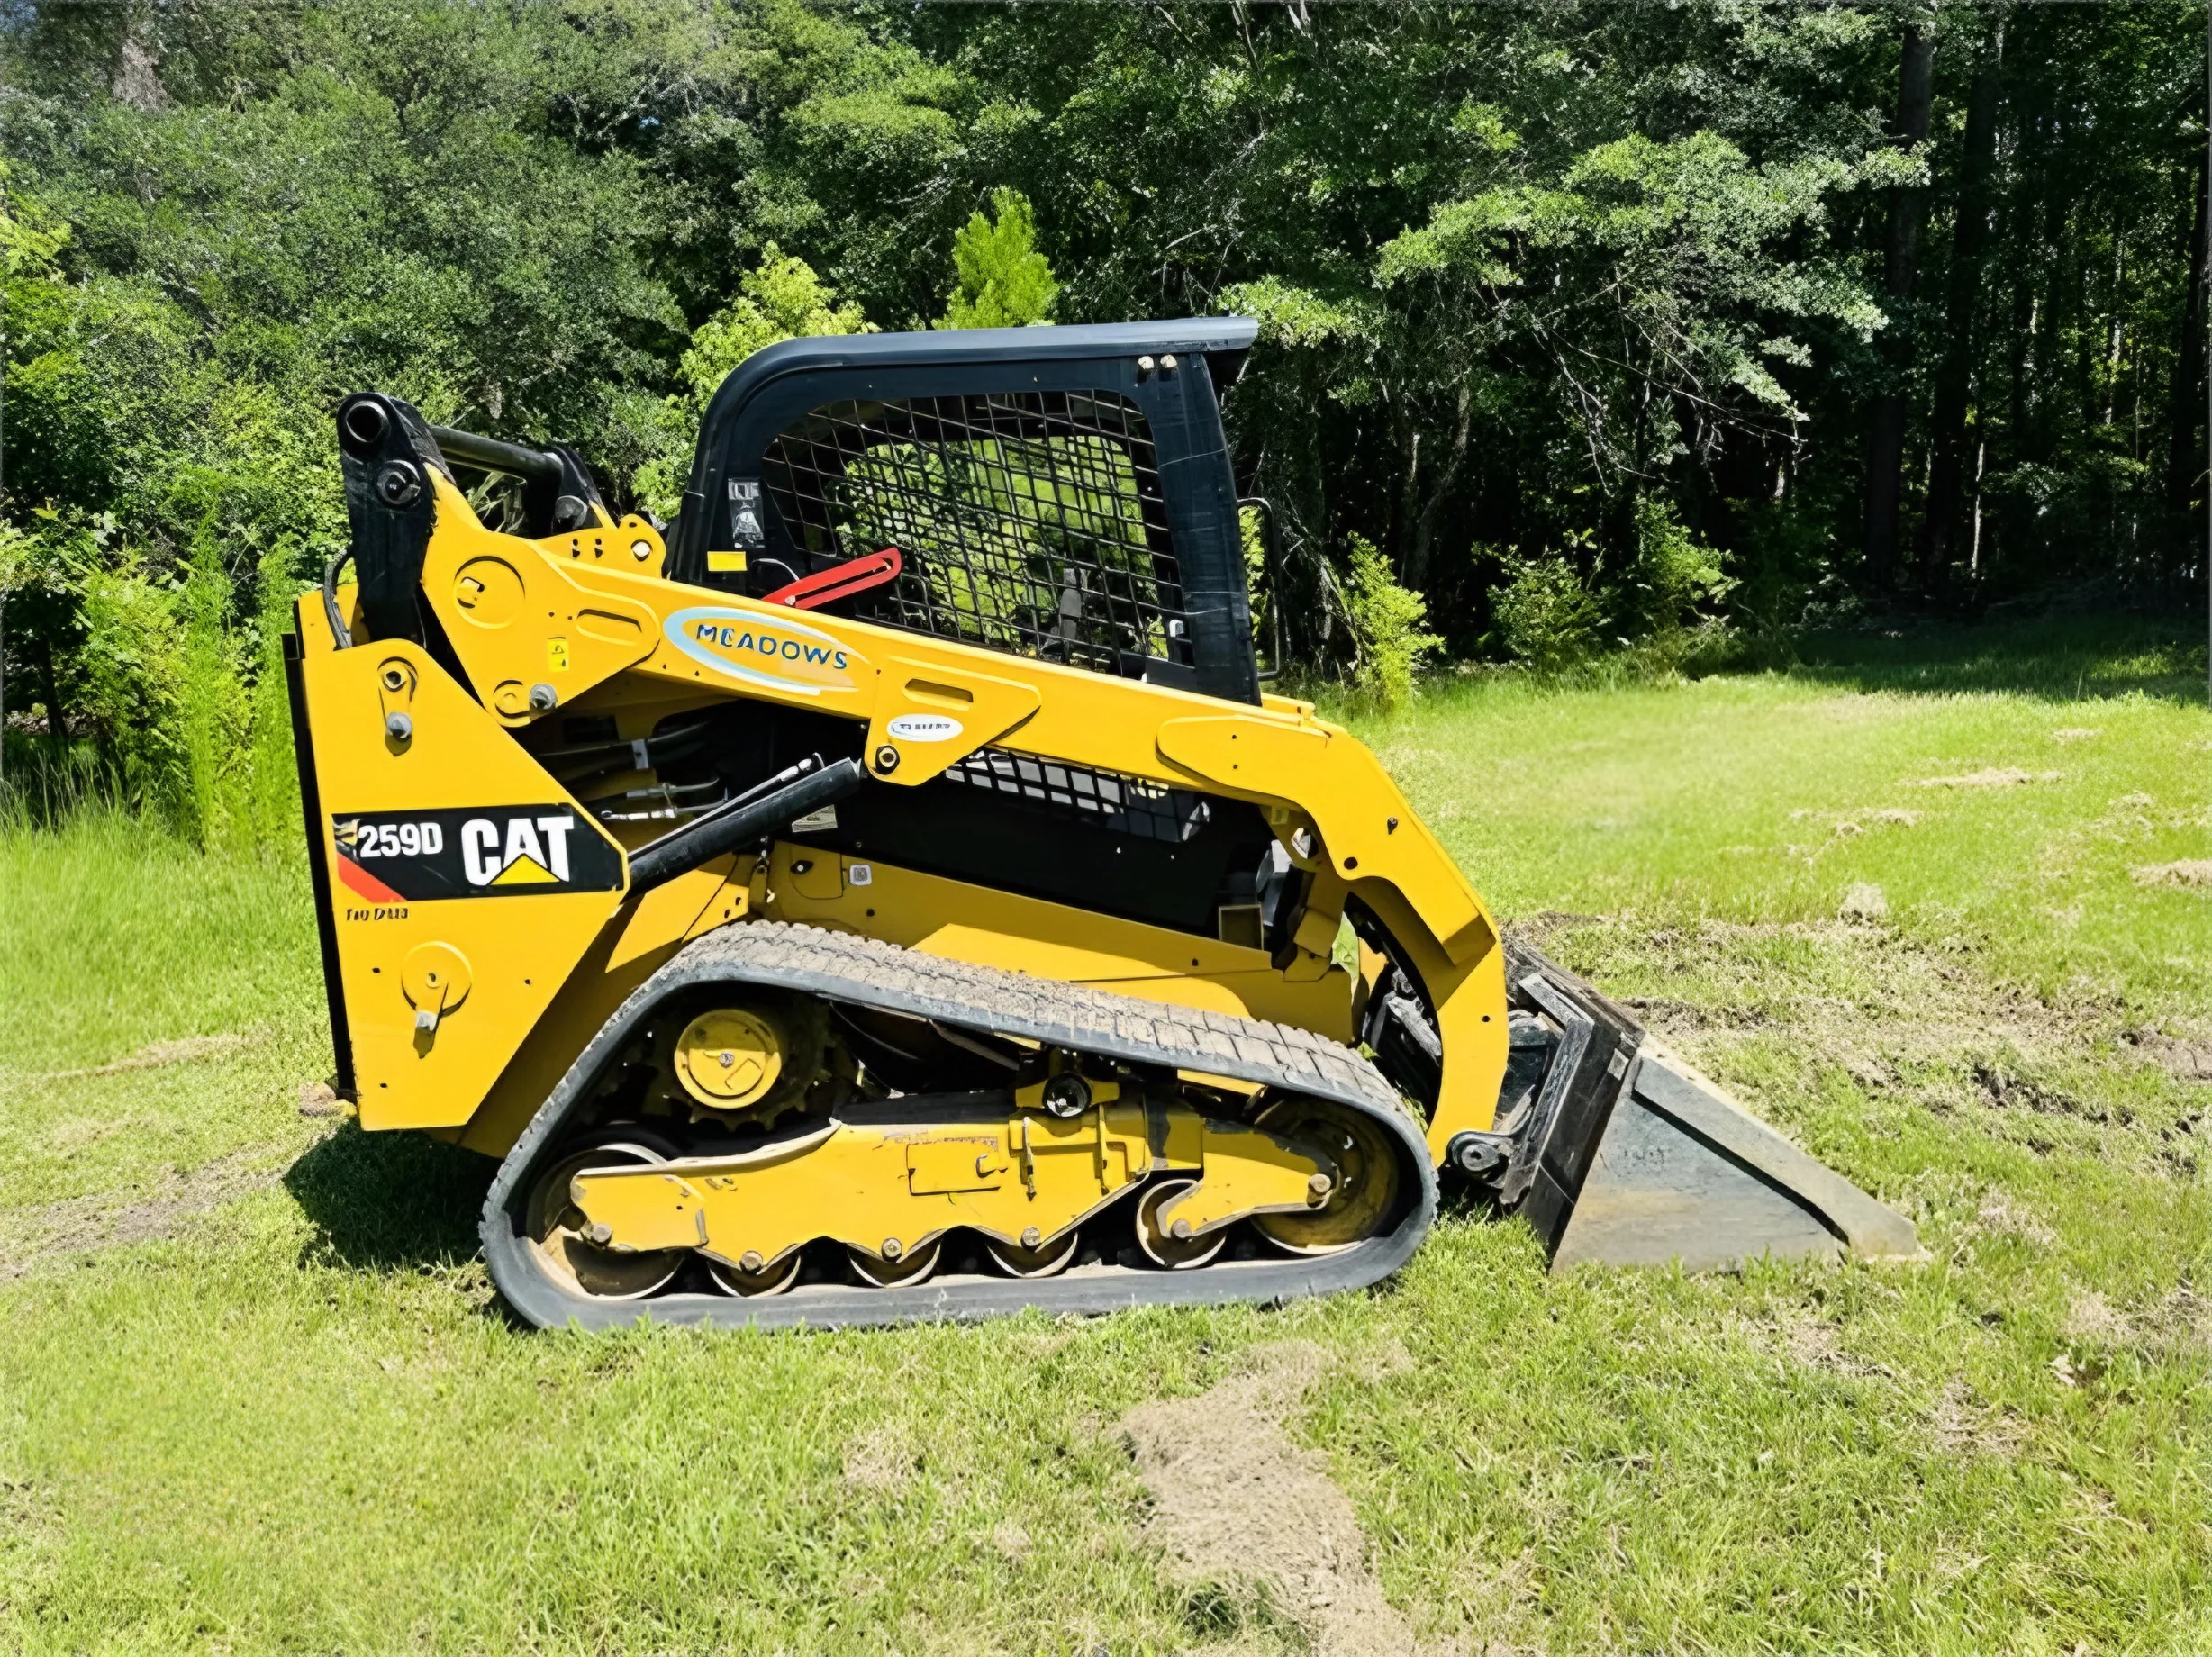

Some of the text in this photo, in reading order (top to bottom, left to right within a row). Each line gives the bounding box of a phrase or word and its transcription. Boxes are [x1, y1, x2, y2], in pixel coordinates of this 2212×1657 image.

[695, 623, 848, 670] MEADOWS
[358, 822, 443, 858] 259D
[460, 816, 574, 886] CAT
